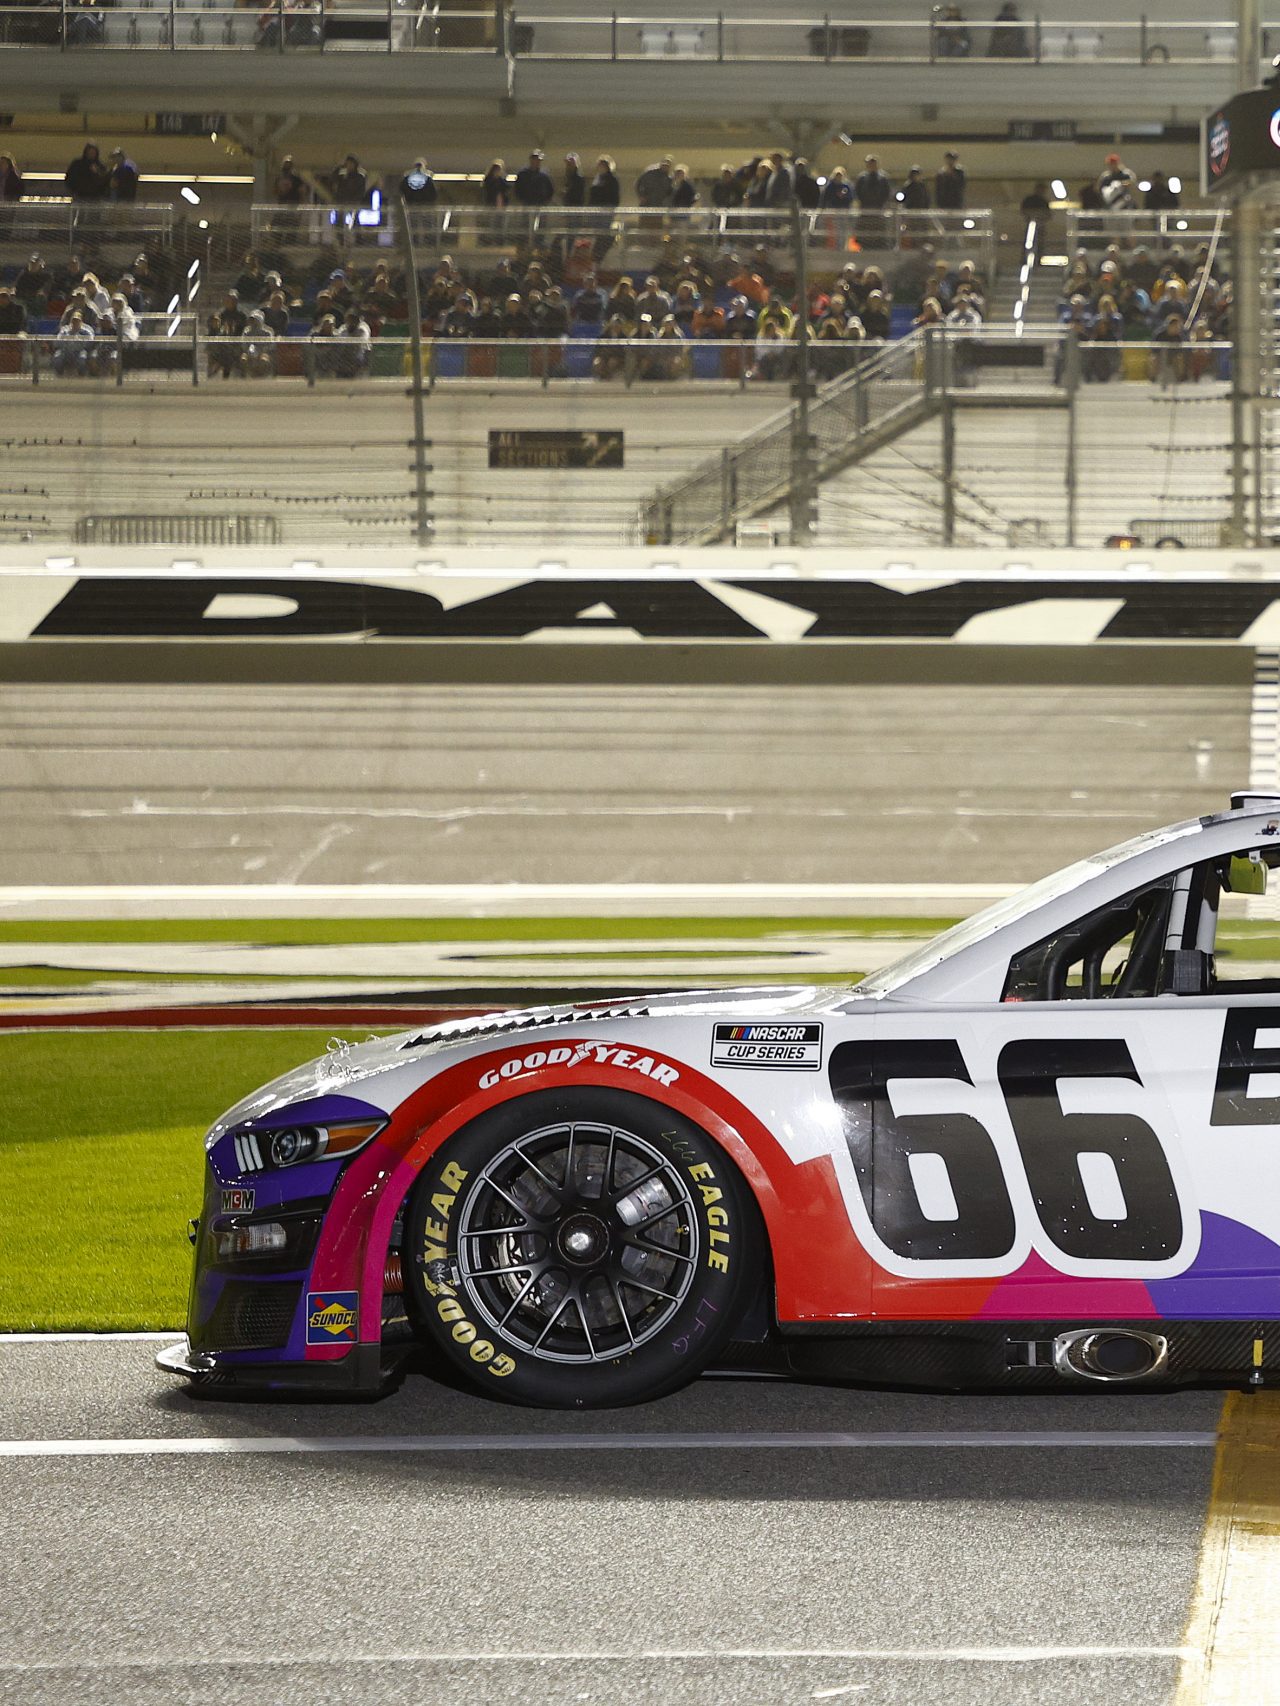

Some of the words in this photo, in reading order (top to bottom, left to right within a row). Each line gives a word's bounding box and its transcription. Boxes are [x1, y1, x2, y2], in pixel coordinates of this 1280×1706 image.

[727, 1045, 756, 1058] CUP
[756, 1046, 806, 1059] SERIES
[748, 1027, 806, 1040] NASCAR
[828, 1039, 1184, 1261] 66
[688, 1161, 730, 1275] EAGLE
